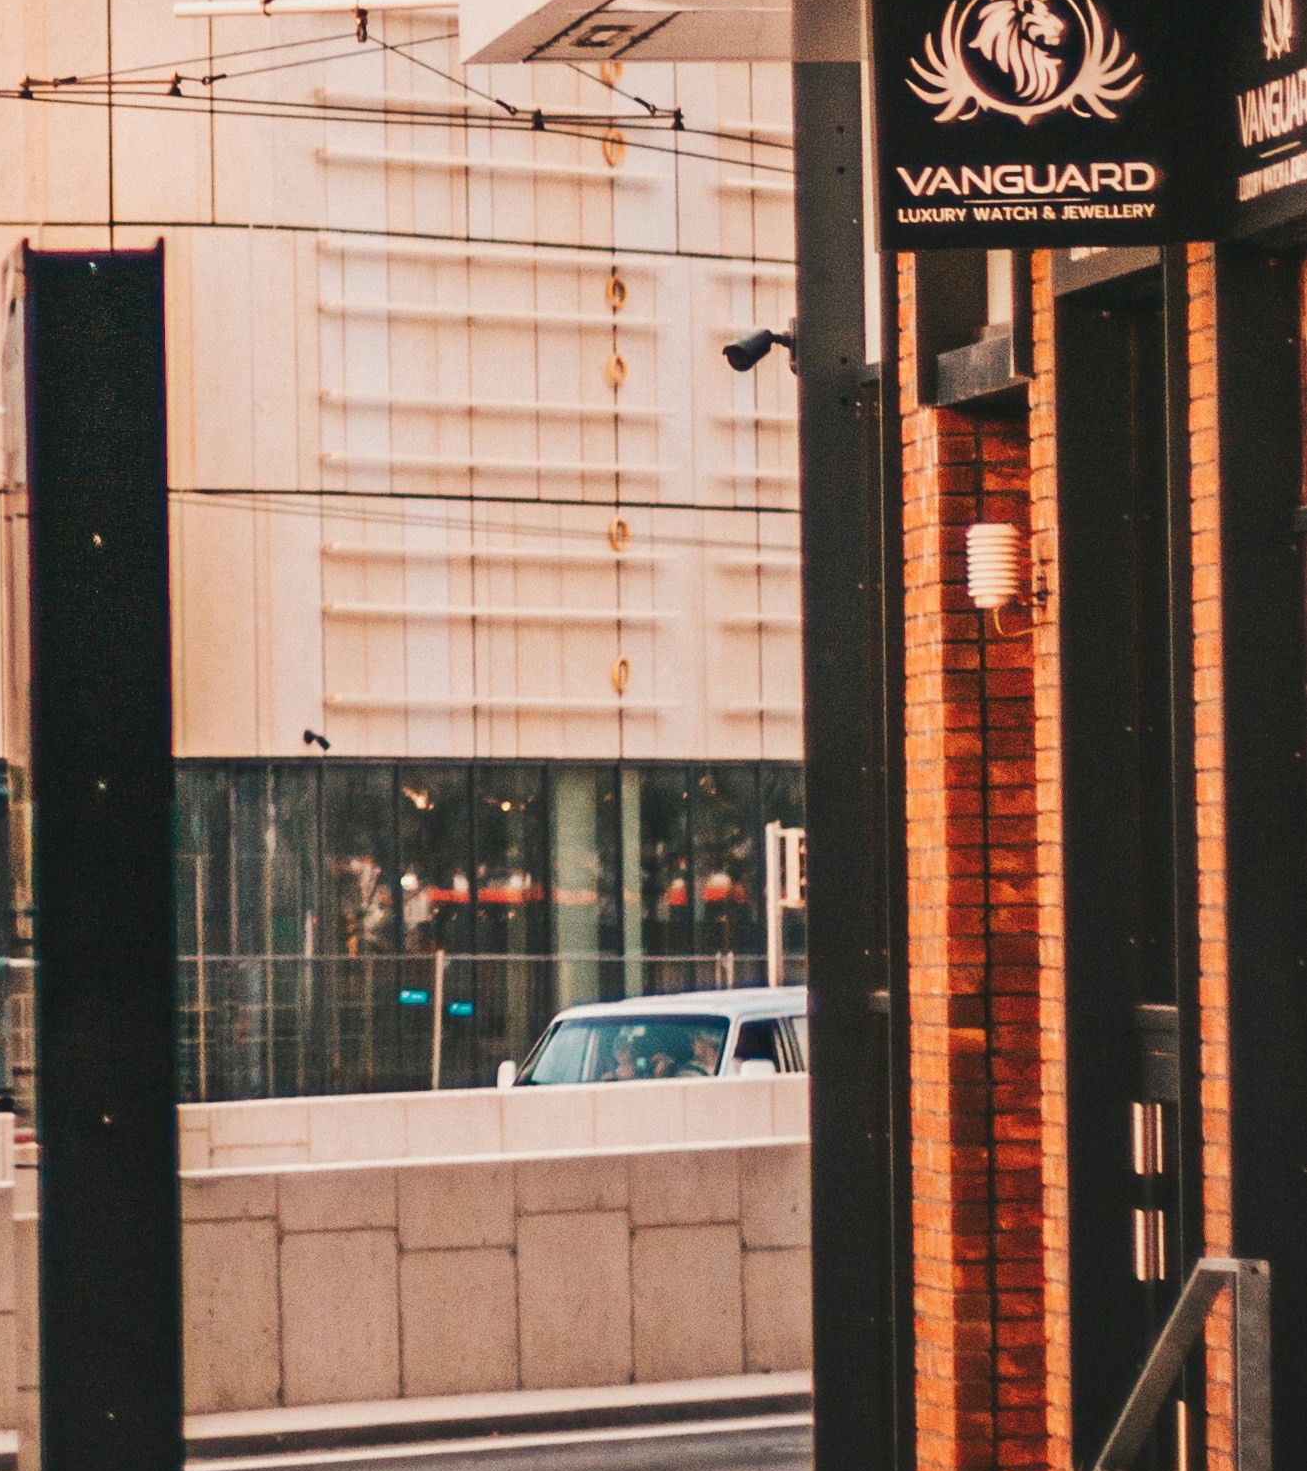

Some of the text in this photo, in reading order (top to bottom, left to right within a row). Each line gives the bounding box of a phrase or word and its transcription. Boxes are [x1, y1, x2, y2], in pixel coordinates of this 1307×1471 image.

[896, 161, 1159, 197] VANGUARD
[897, 202, 1157, 224] LUXURY WATCH & JEWELLERY
